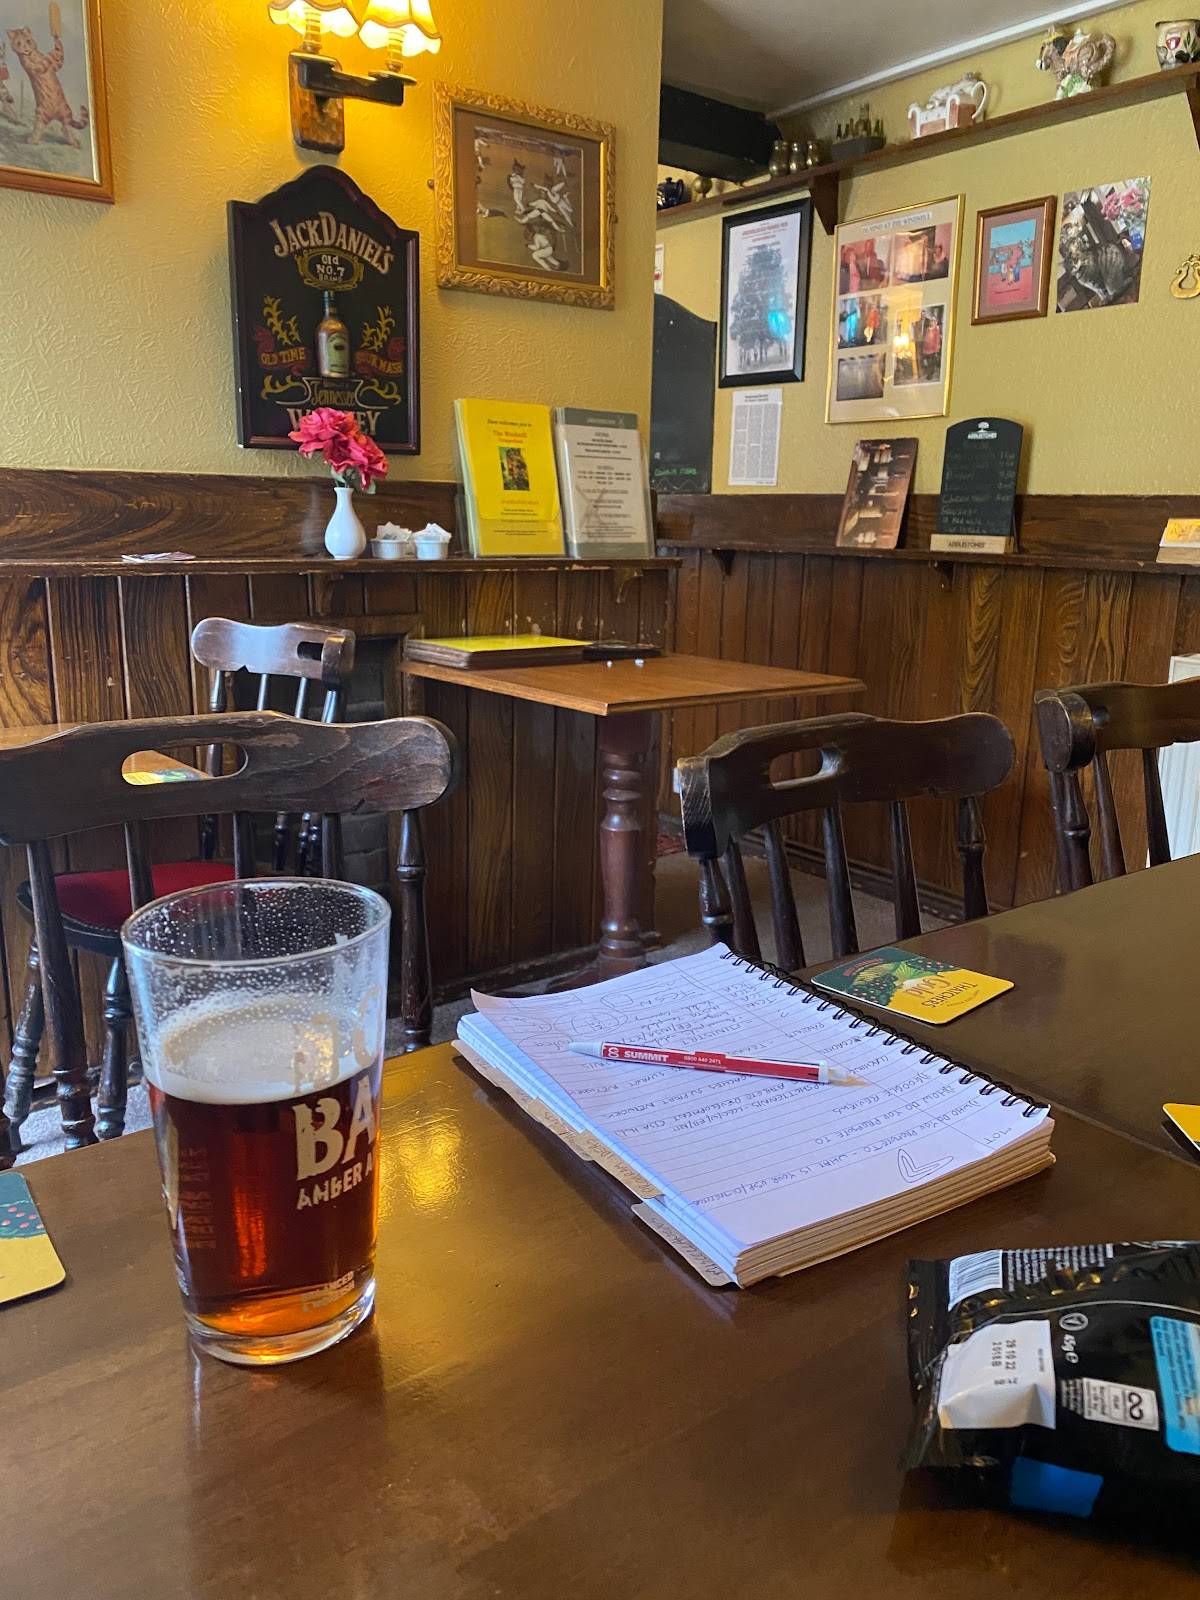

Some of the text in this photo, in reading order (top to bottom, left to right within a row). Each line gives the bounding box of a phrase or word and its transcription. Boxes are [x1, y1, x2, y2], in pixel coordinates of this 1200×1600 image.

[281, 346, 307, 363] TIME
[920, 980, 978, 1009] THATCHERS
[624, 1050, 670, 1063] SUMMIT
[296, 1161, 363, 1211] AMBER
